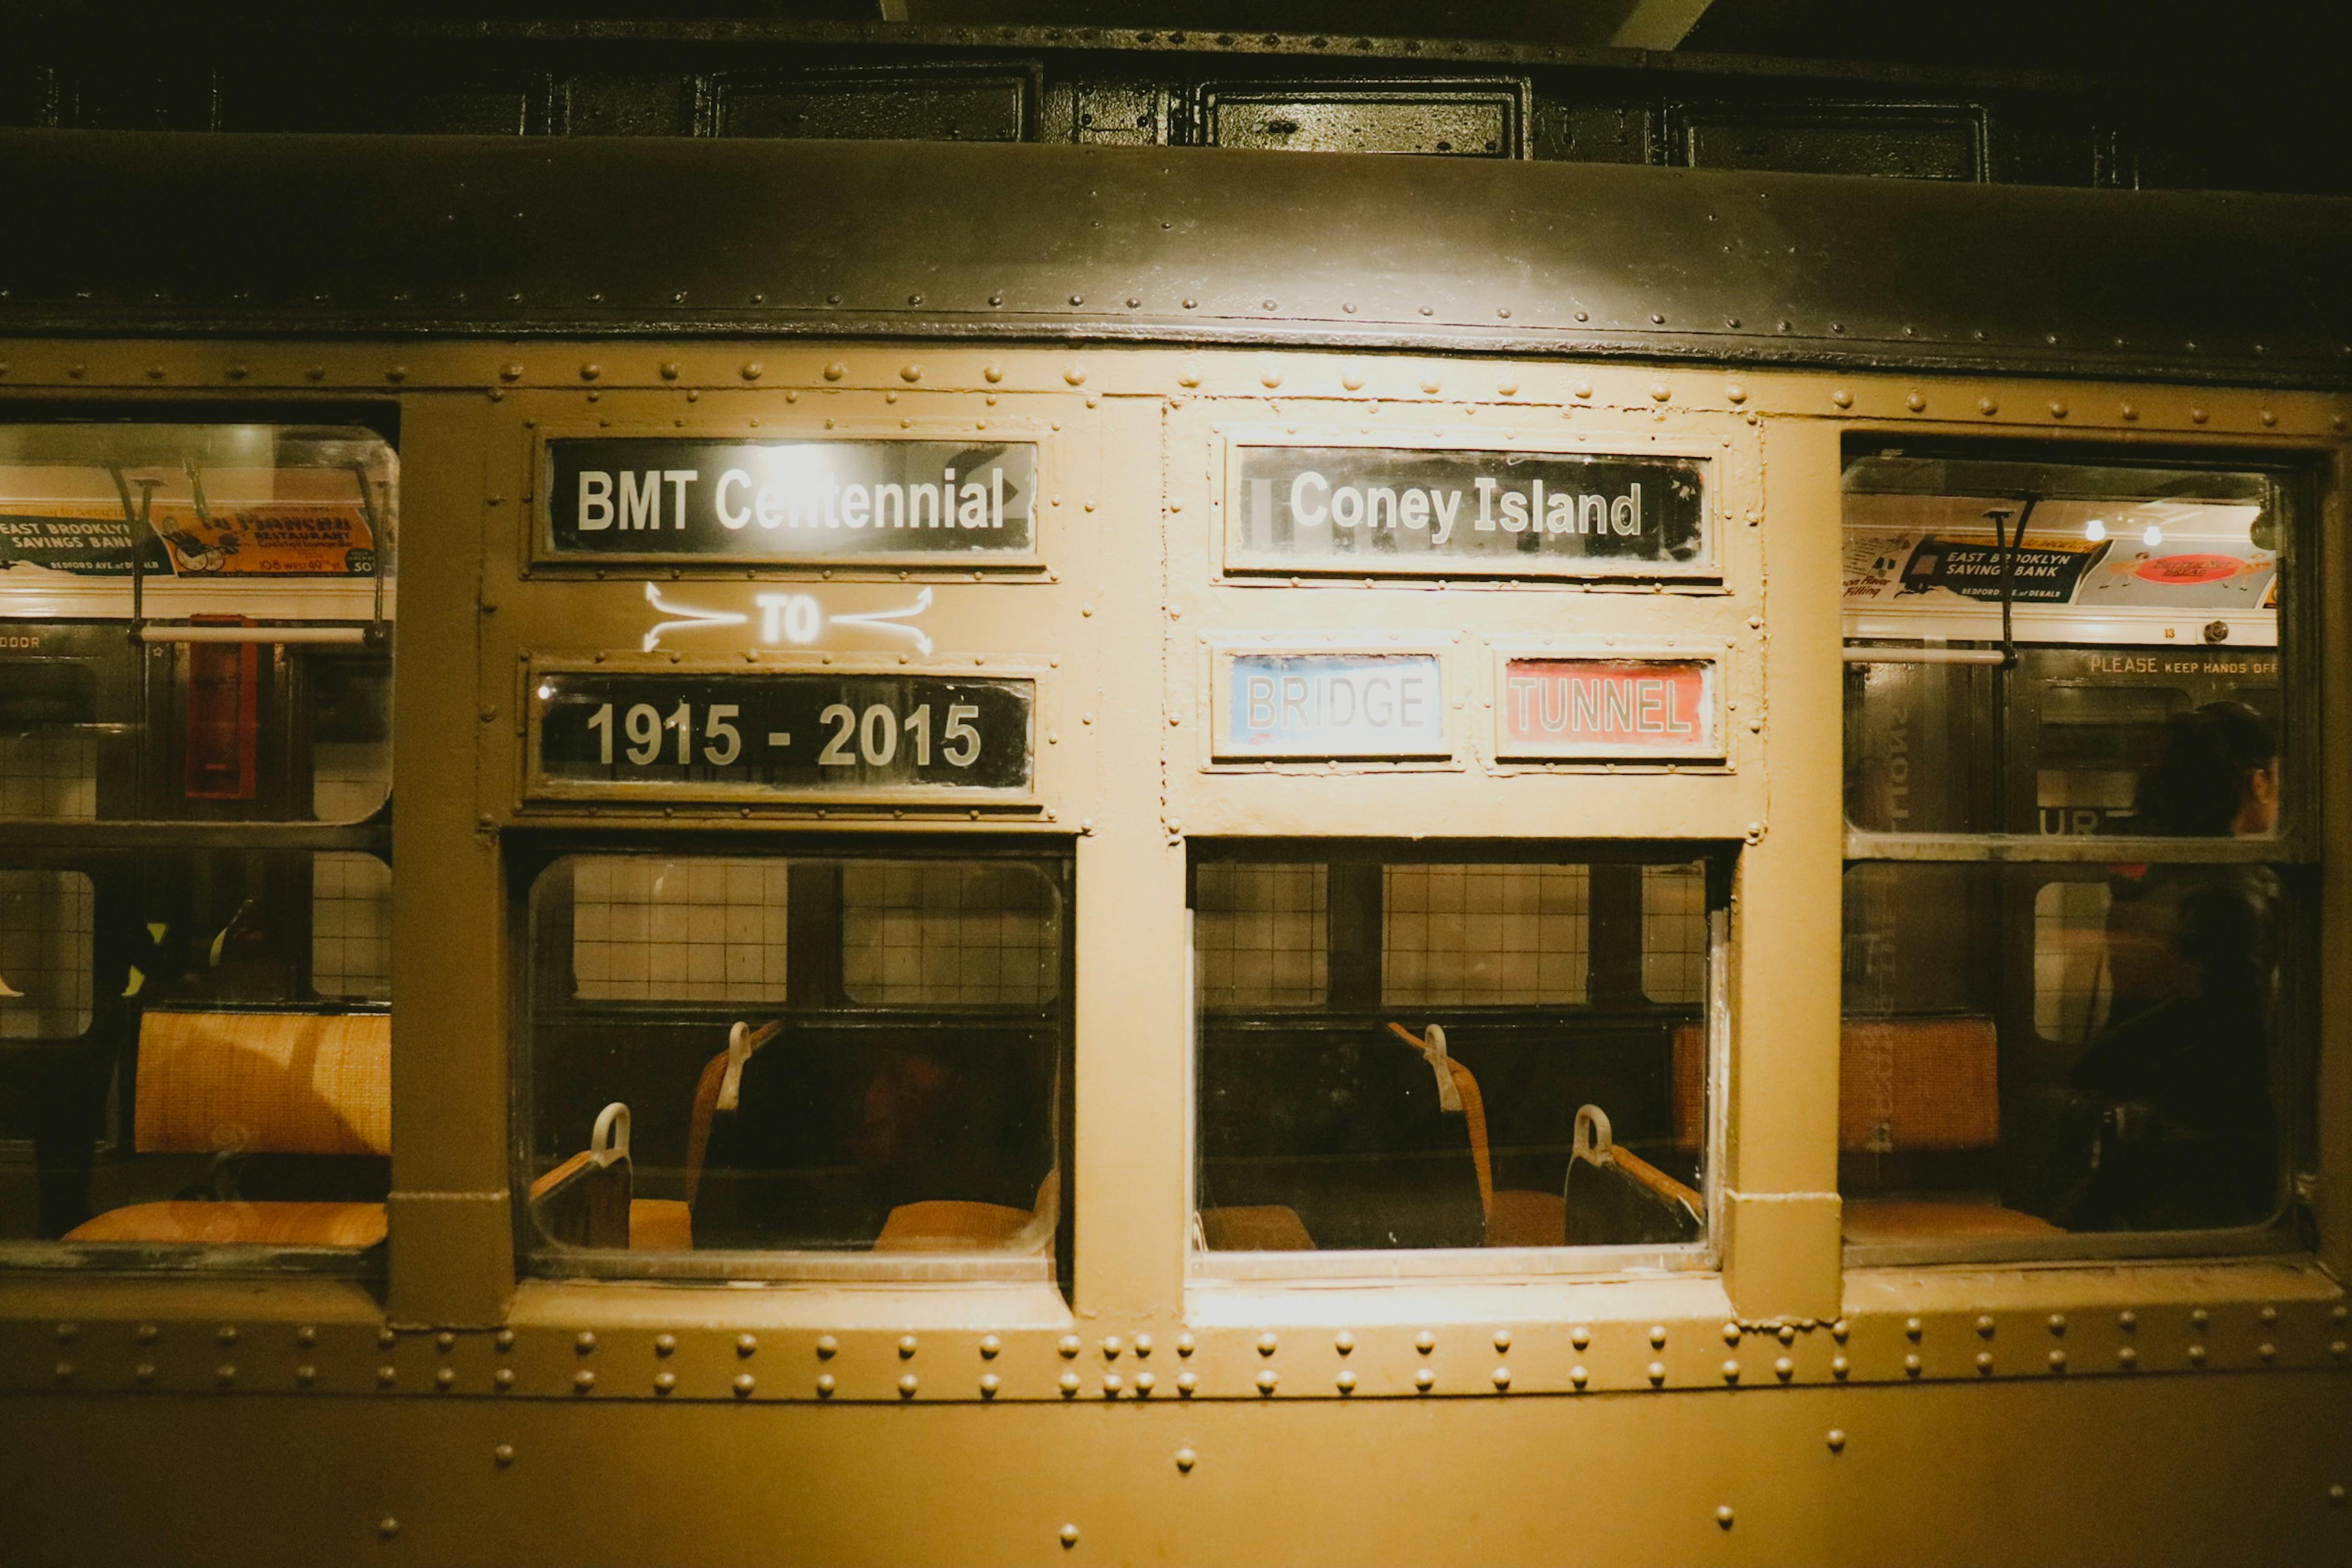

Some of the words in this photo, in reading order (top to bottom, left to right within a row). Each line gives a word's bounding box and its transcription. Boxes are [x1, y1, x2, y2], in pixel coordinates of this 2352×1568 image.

[578, 469, 698, 531] BMT
[715, 468, 1003, 530] Centennial
[1289, 471, 1462, 545] Coney
[1474, 476, 1641, 536] Island
[0, 523, 40, 534] EAST
[11, 537, 84, 548] SAVINGS
[1947, 552, 1986, 562] EAST
[259, 559, 281, 571] 108
[1946, 564, 2009, 576] SAVING
[2014, 566, 2059, 577] BANK
[1861, 575, 1891, 586] Flavor
[1843, 585, 1881, 599] Filling
[1962, 588, 1999, 596] BEDFORD
[2028, 590, 2061, 598] DEKALB
[756, 593, 820, 645] TO
[2164, 628, 2175, 639] 13
[2090, 656, 2158, 673] PLEASE
[2165, 663, 2198, 673] KEEP
[2203, 663, 2247, 674] HANDS
[2253, 663, 2278, 673] OFF
[1246, 675, 1425, 730] BRIDGE
[1509, 677, 1693, 733] TUNNEL
[587, 702, 741, 767] 1915
[818, 703, 982, 767] 2015
